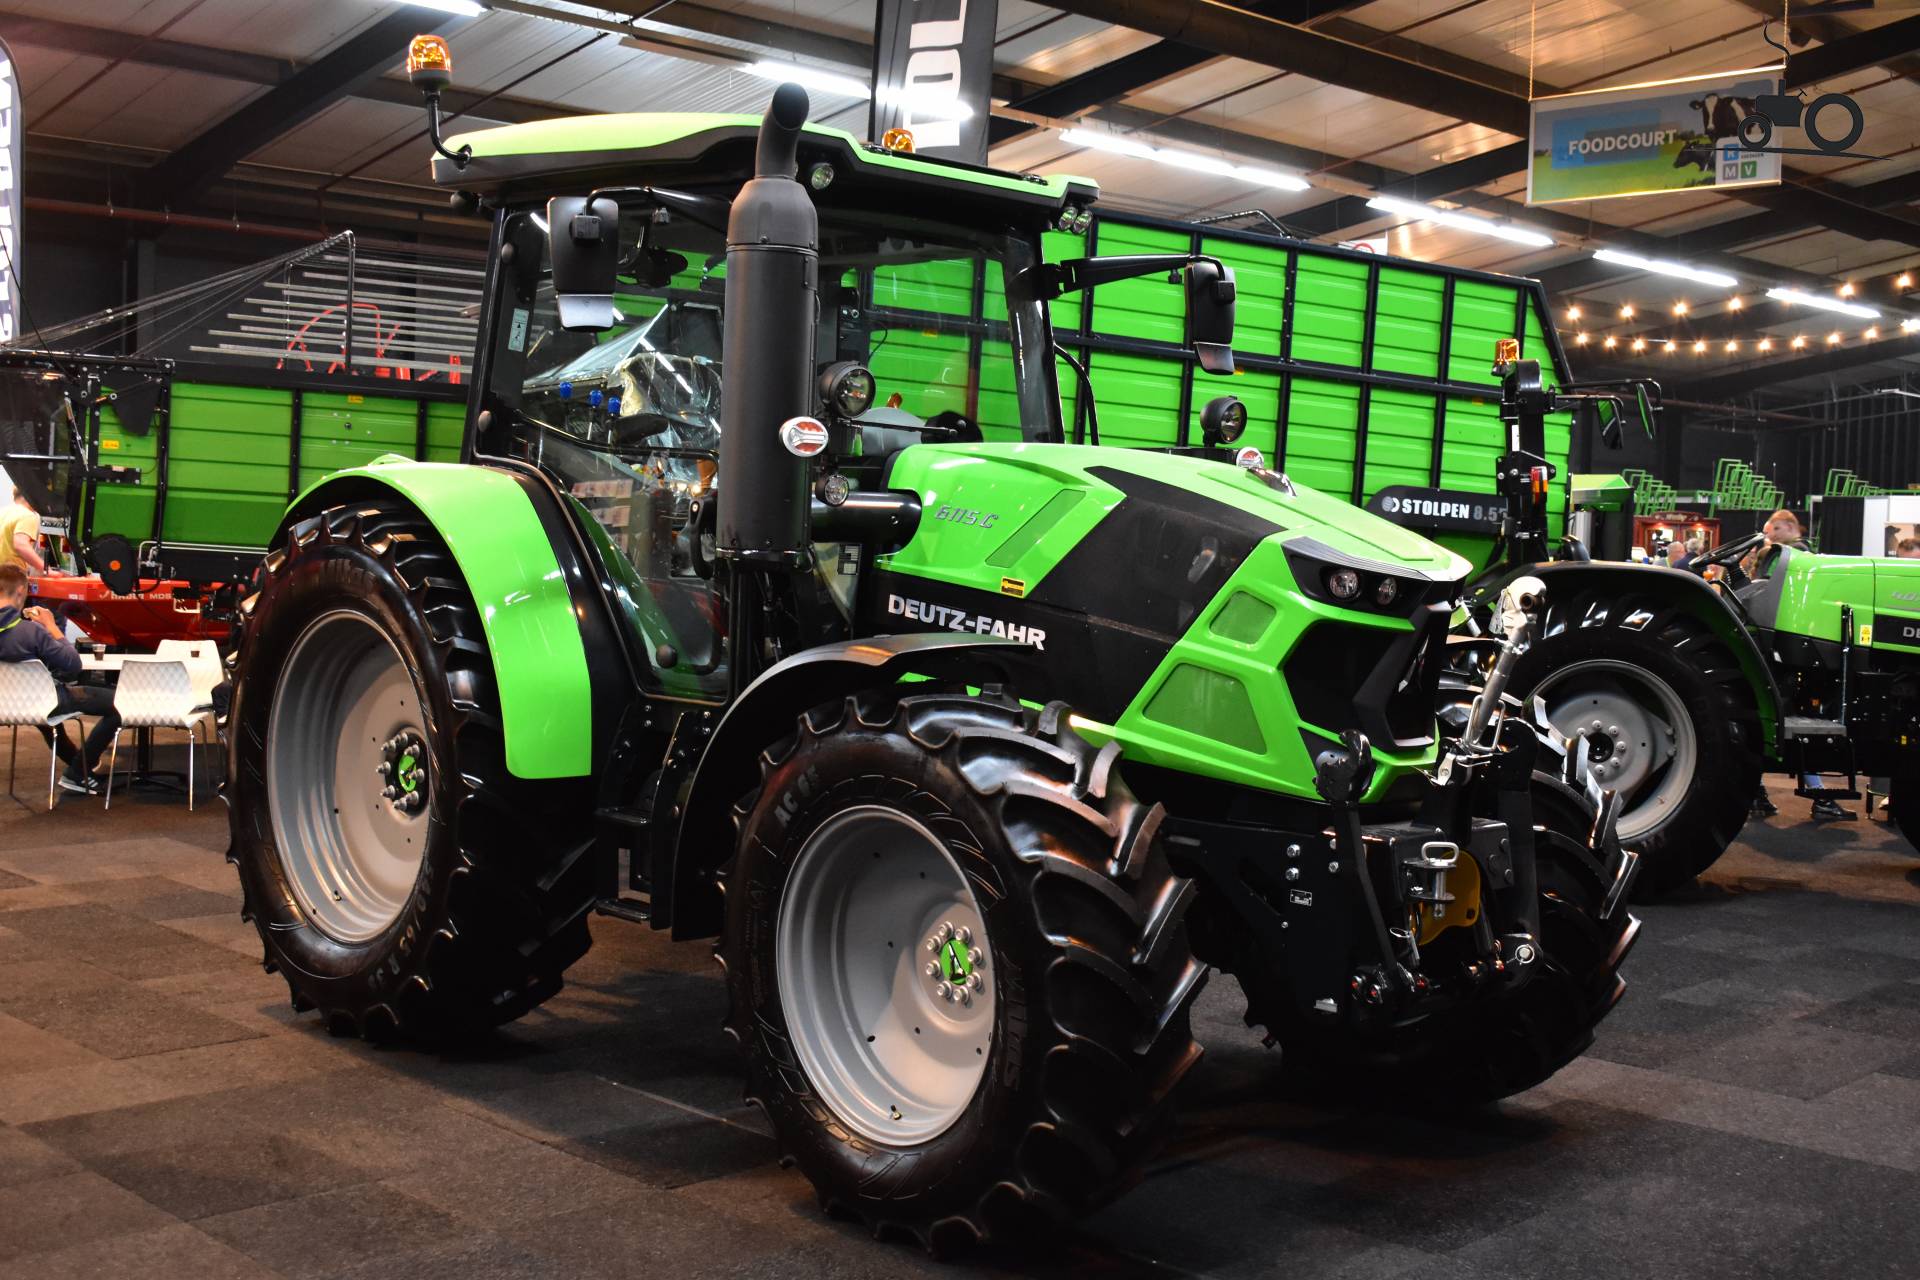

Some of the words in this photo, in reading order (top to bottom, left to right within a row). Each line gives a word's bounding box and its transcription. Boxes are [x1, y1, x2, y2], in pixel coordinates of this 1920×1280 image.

[1567, 128, 1678, 156] FOODCOURT
[1724, 164, 1737, 178] M
[1401, 498, 1470, 519] STOLPEN
[887, 593, 1046, 651] DEUTZ-FAHR
